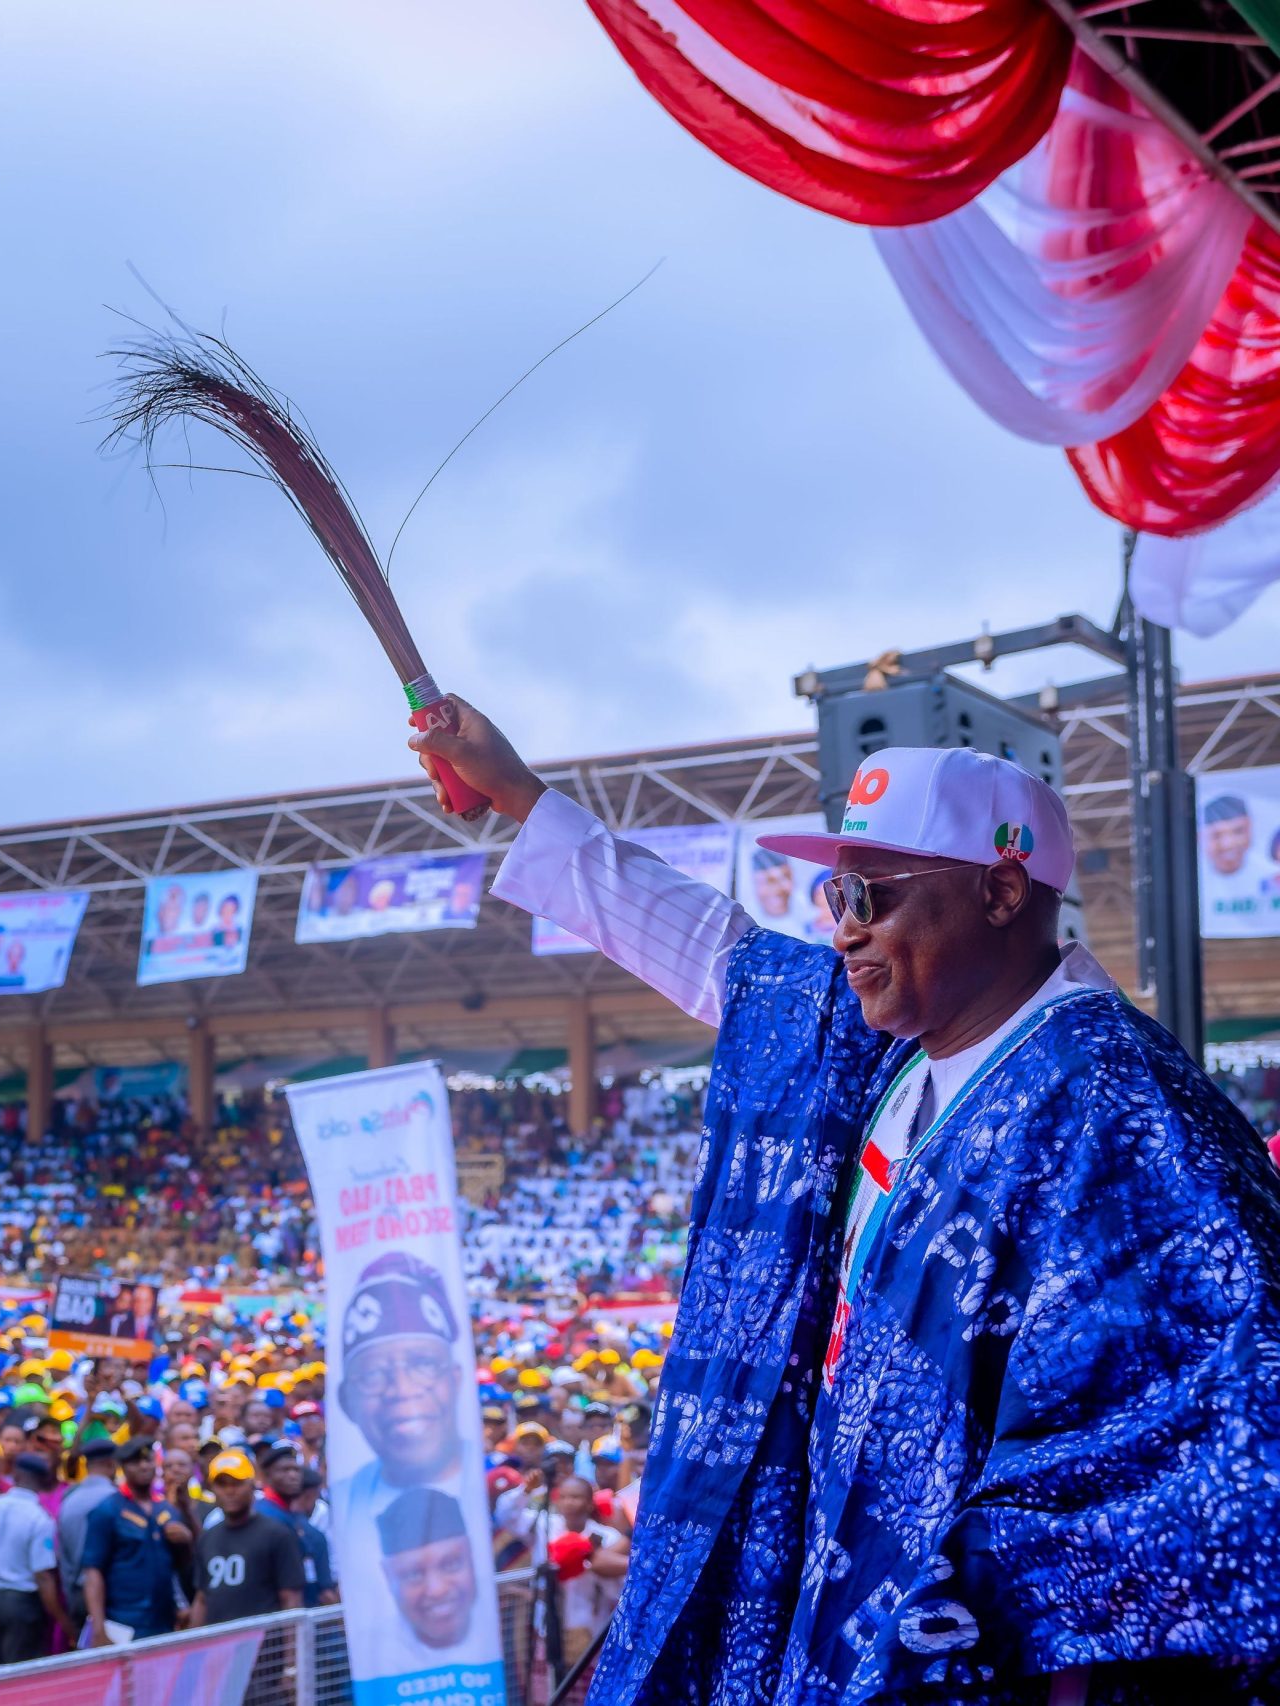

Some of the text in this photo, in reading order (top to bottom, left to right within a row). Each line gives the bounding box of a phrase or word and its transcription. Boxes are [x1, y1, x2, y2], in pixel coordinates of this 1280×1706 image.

[844, 819, 867, 831] Term
[1001, 848, 1025, 861] APC
[208, 1555, 245, 1589] 90
